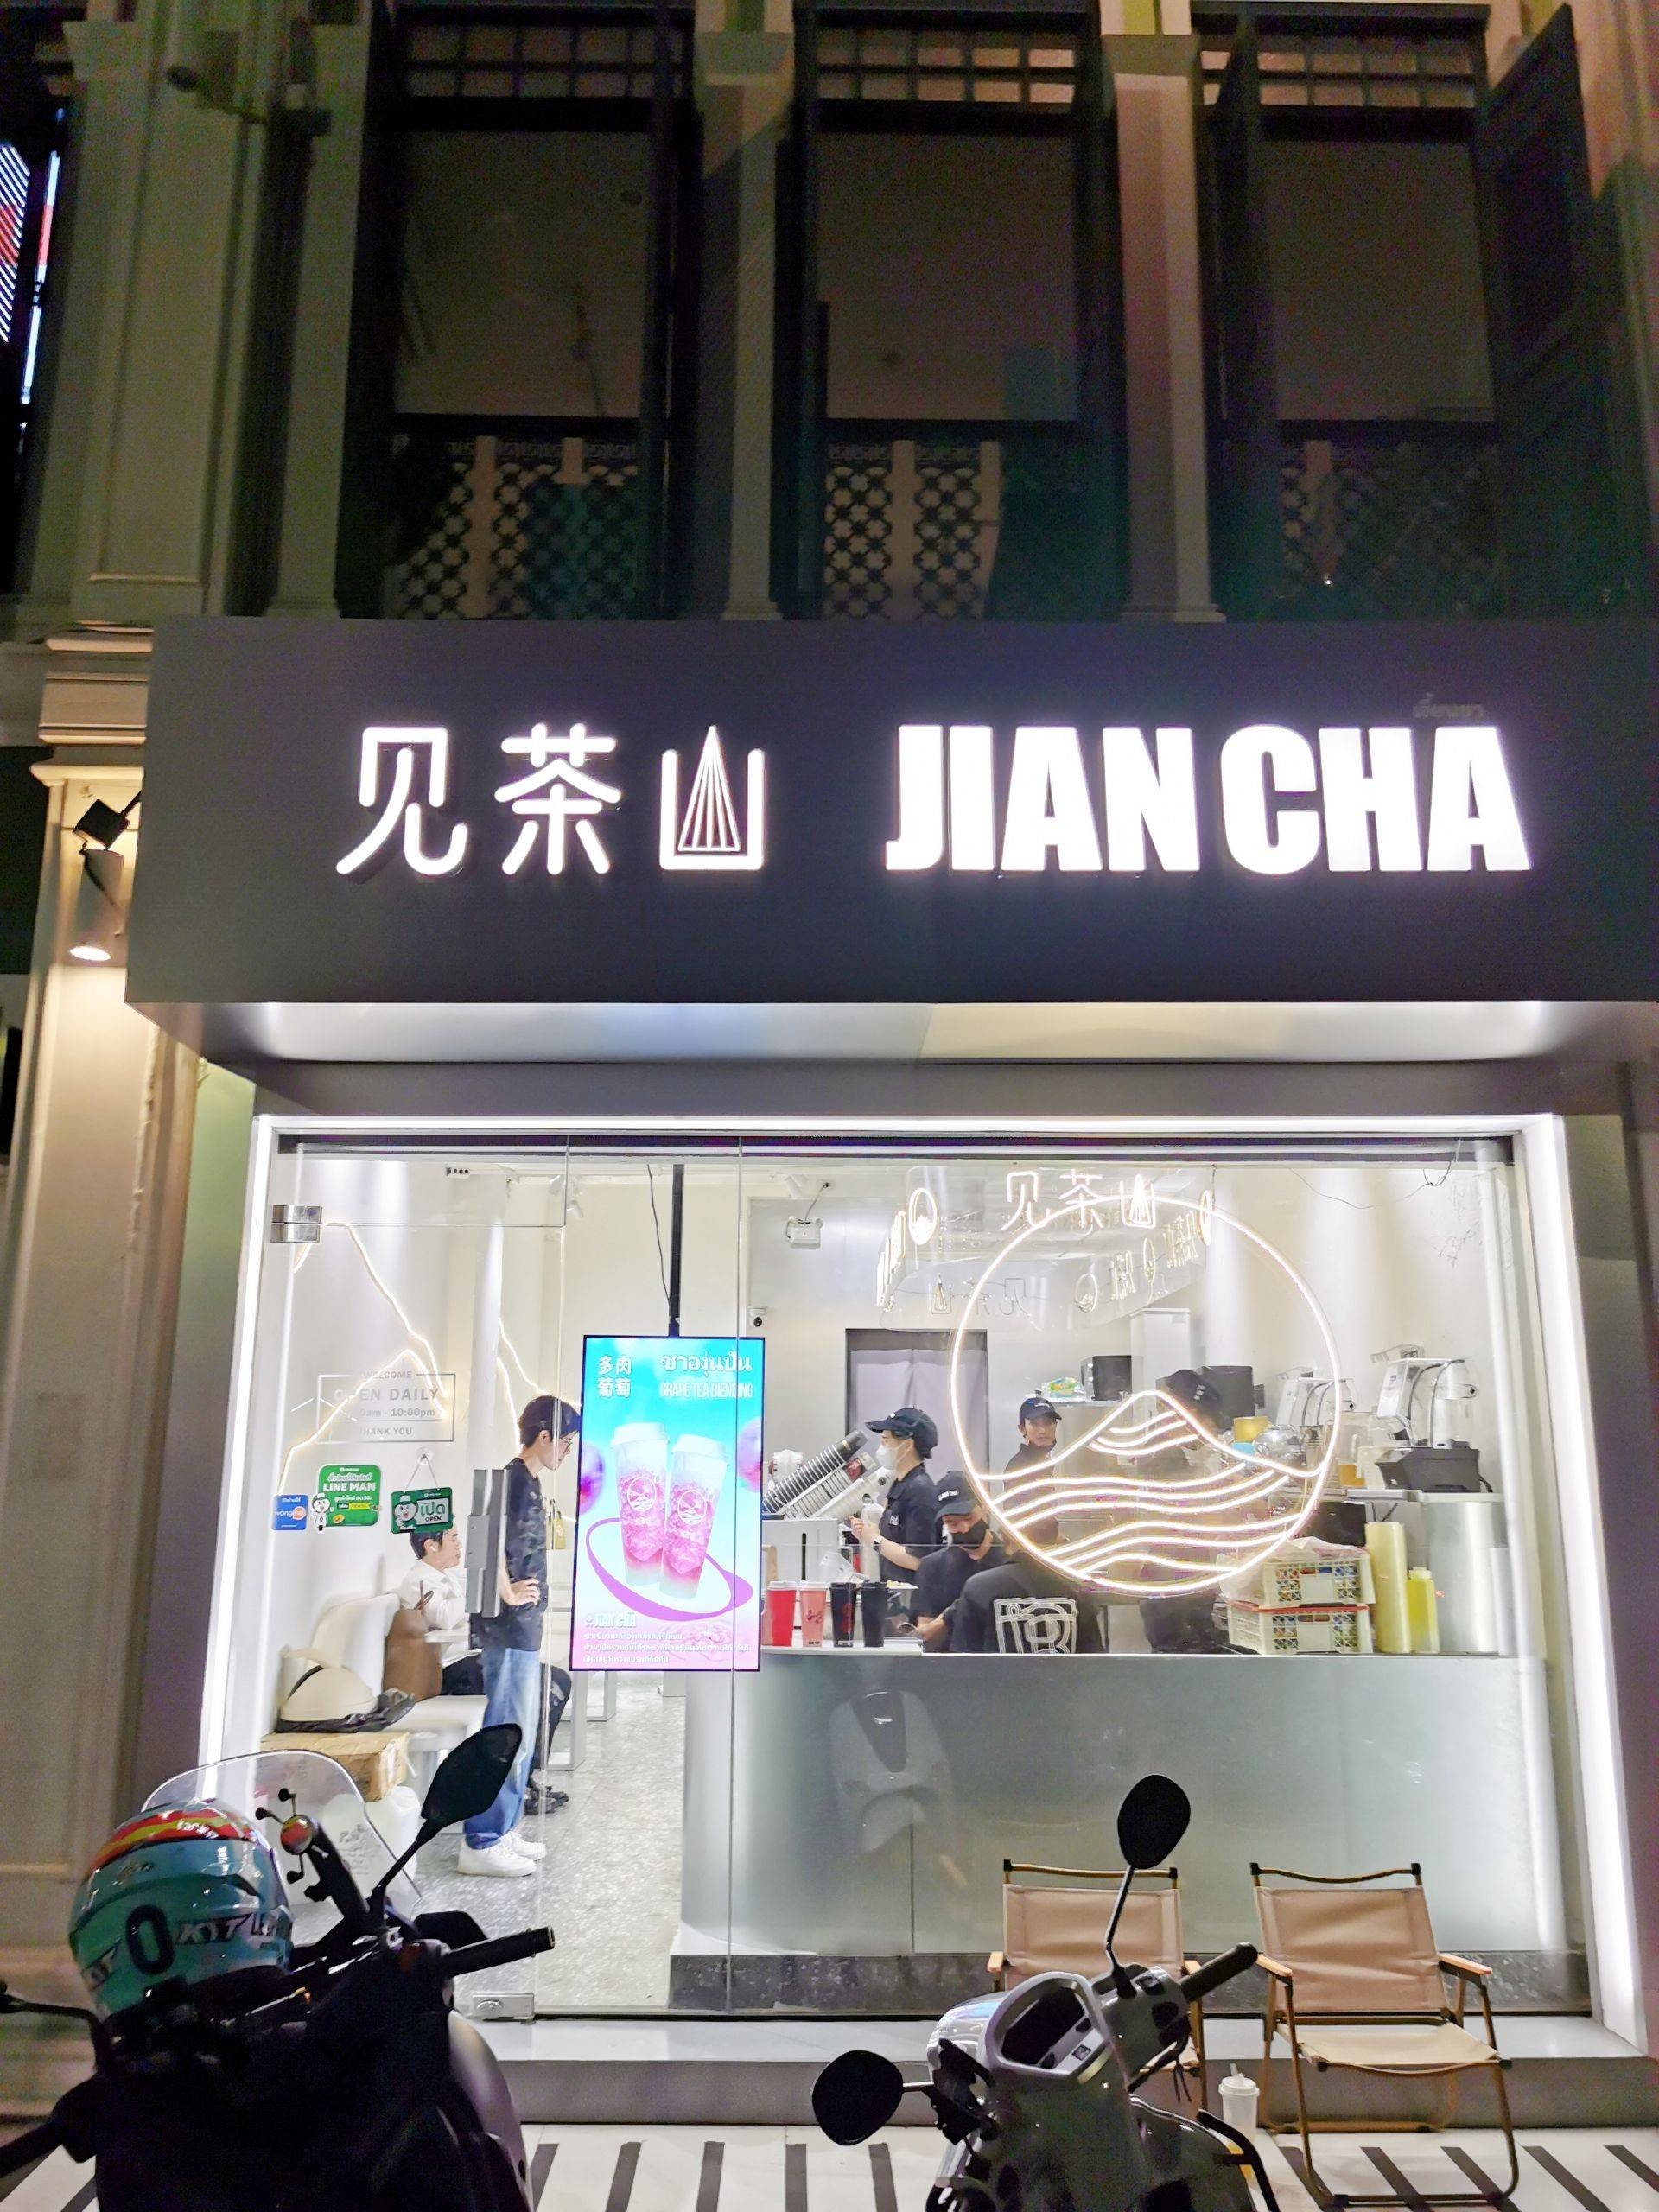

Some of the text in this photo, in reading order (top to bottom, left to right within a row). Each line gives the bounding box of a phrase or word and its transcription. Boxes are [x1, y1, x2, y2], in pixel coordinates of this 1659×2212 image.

[335, 721, 766, 876] 见茶山
[885, 723, 1533, 875] JIAN CHA
[598, 1355, 632, 1376] 多肉
[660, 1350, 753, 1377] ชาองุ่นปั่น
[334, 1388, 439, 1401] OEN DAILY
[660, 1382, 690, 1398] GRAPE
[692, 1382, 710, 1398] TEA
[390, 1407, 435, 1418] 10:00pm
[359, 1427, 413, 1436] HANK YOU
[323, 1483, 376, 1492] LINE MAN
[420, 1501, 446, 1516] เปิด
